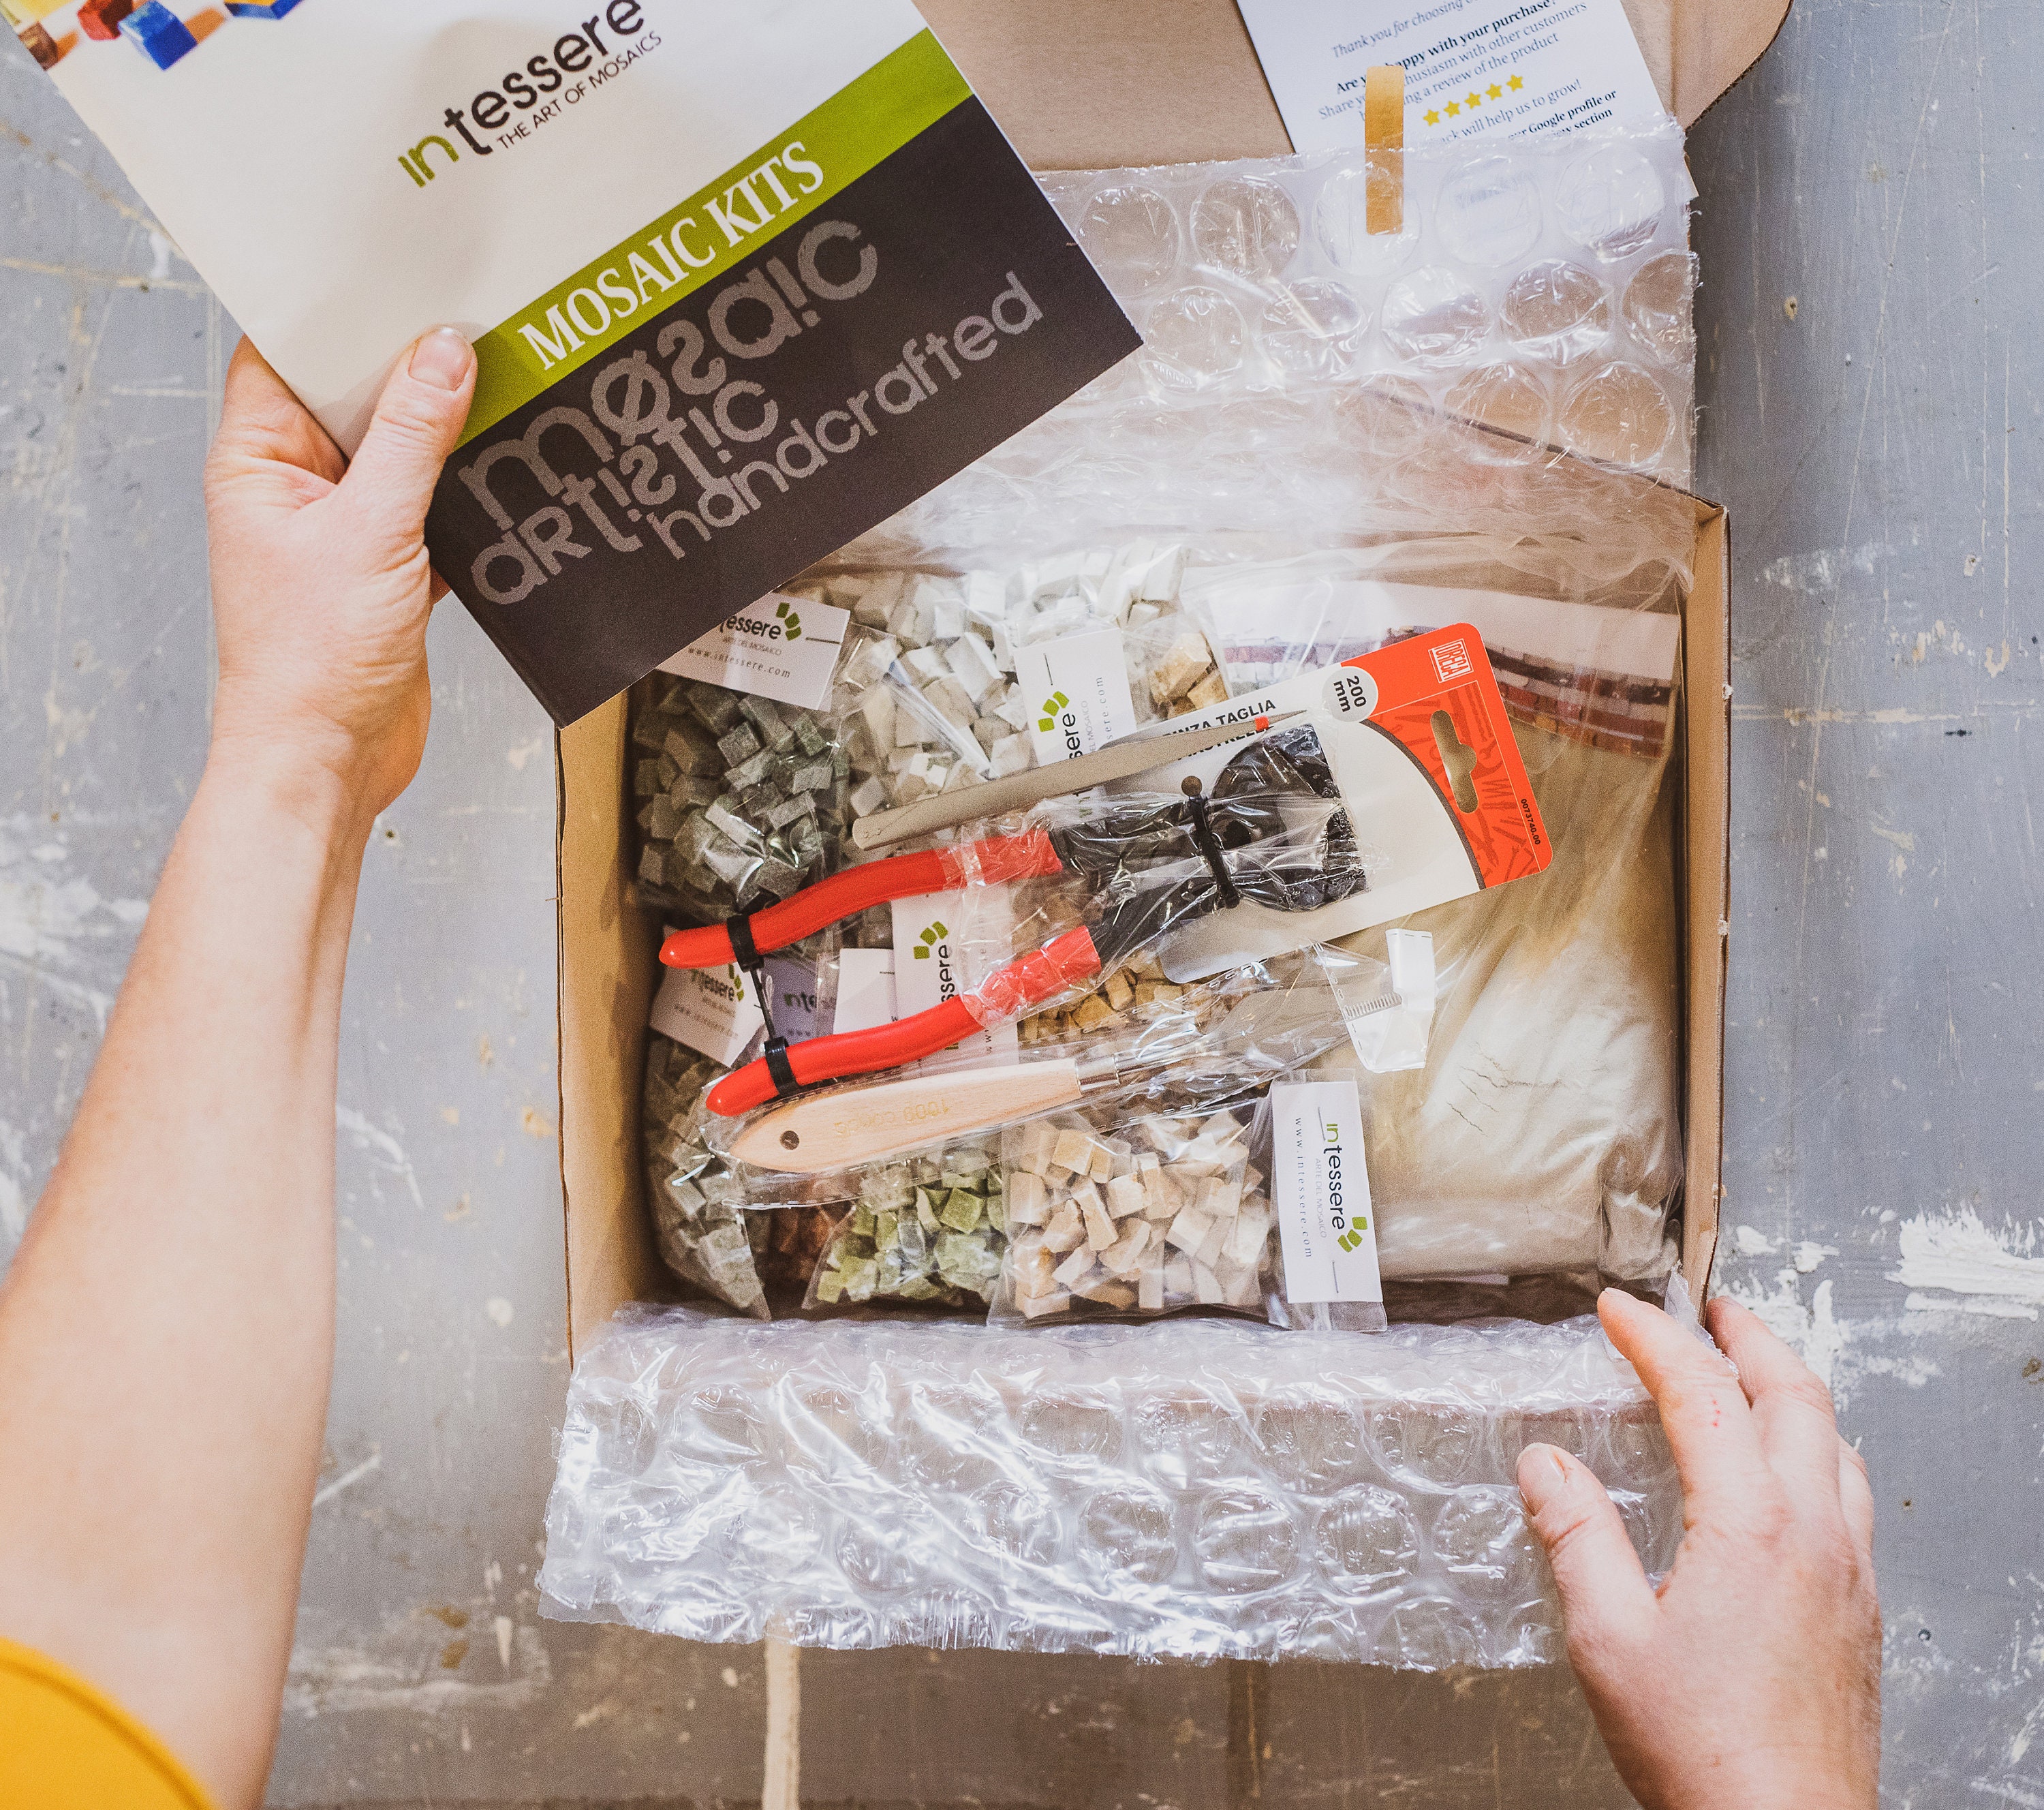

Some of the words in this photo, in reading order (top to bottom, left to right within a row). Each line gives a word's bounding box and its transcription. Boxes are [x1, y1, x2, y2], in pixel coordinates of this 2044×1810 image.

[1331, 35, 1369, 57] Thank
[1371, 27, 1392, 47] you
[1391, 20, 1410, 37] for
[1411, 0, 1463, 26] choosing
[1428, 37, 1459, 56] with
[1459, 25, 1490, 46] your
[1459, 43, 1488, 63] with
[1489, 31, 1521, 50] other
[1523, 2, 1588, 35] customers
[1337, 78, 1359, 93] Are
[1423, 87, 1431, 97] a
[1433, 70, 1472, 93] review
[1474, 59, 1487, 75] of
[1488, 55, 1508, 70] the
[1511, 32, 1559, 63] product
[398, 0, 644, 187] intessere
[496, 122, 531, 150] THE
[533, 100, 562, 129] ART
[564, 83, 587, 104] OF
[589, 30, 662, 86] MOSAICS
[1318, 99, 1354, 120] Share
[1461, 119, 1485, 137] will
[1486, 108, 1514, 128] help
[1516, 102, 1530, 115] us
[1532, 95, 1546, 108] to
[1547, 78, 1582, 104] grow!
[1528, 112, 1566, 134] Google
[1568, 97, 1602, 120] profile
[1605, 90, 1617, 102] or
[1574, 108, 1613, 129] section
[518, 217, 717, 371] MOSAIC
[703, 140, 824, 248] KITS
[1216, 699, 1276, 724] TAGLIA
[1333, 680, 1351, 713] mm
[1346, 675, 1367, 708] 200
[1521, 799, 1541, 845] 0073740.00
[1295, 1117, 1312, 1257] www.intessere.com
[1315, 1159, 1323, 1179] ARTE
[1323, 1123, 1345, 1230] intessere
[1316, 1198, 1327, 1238] MOSAICO
